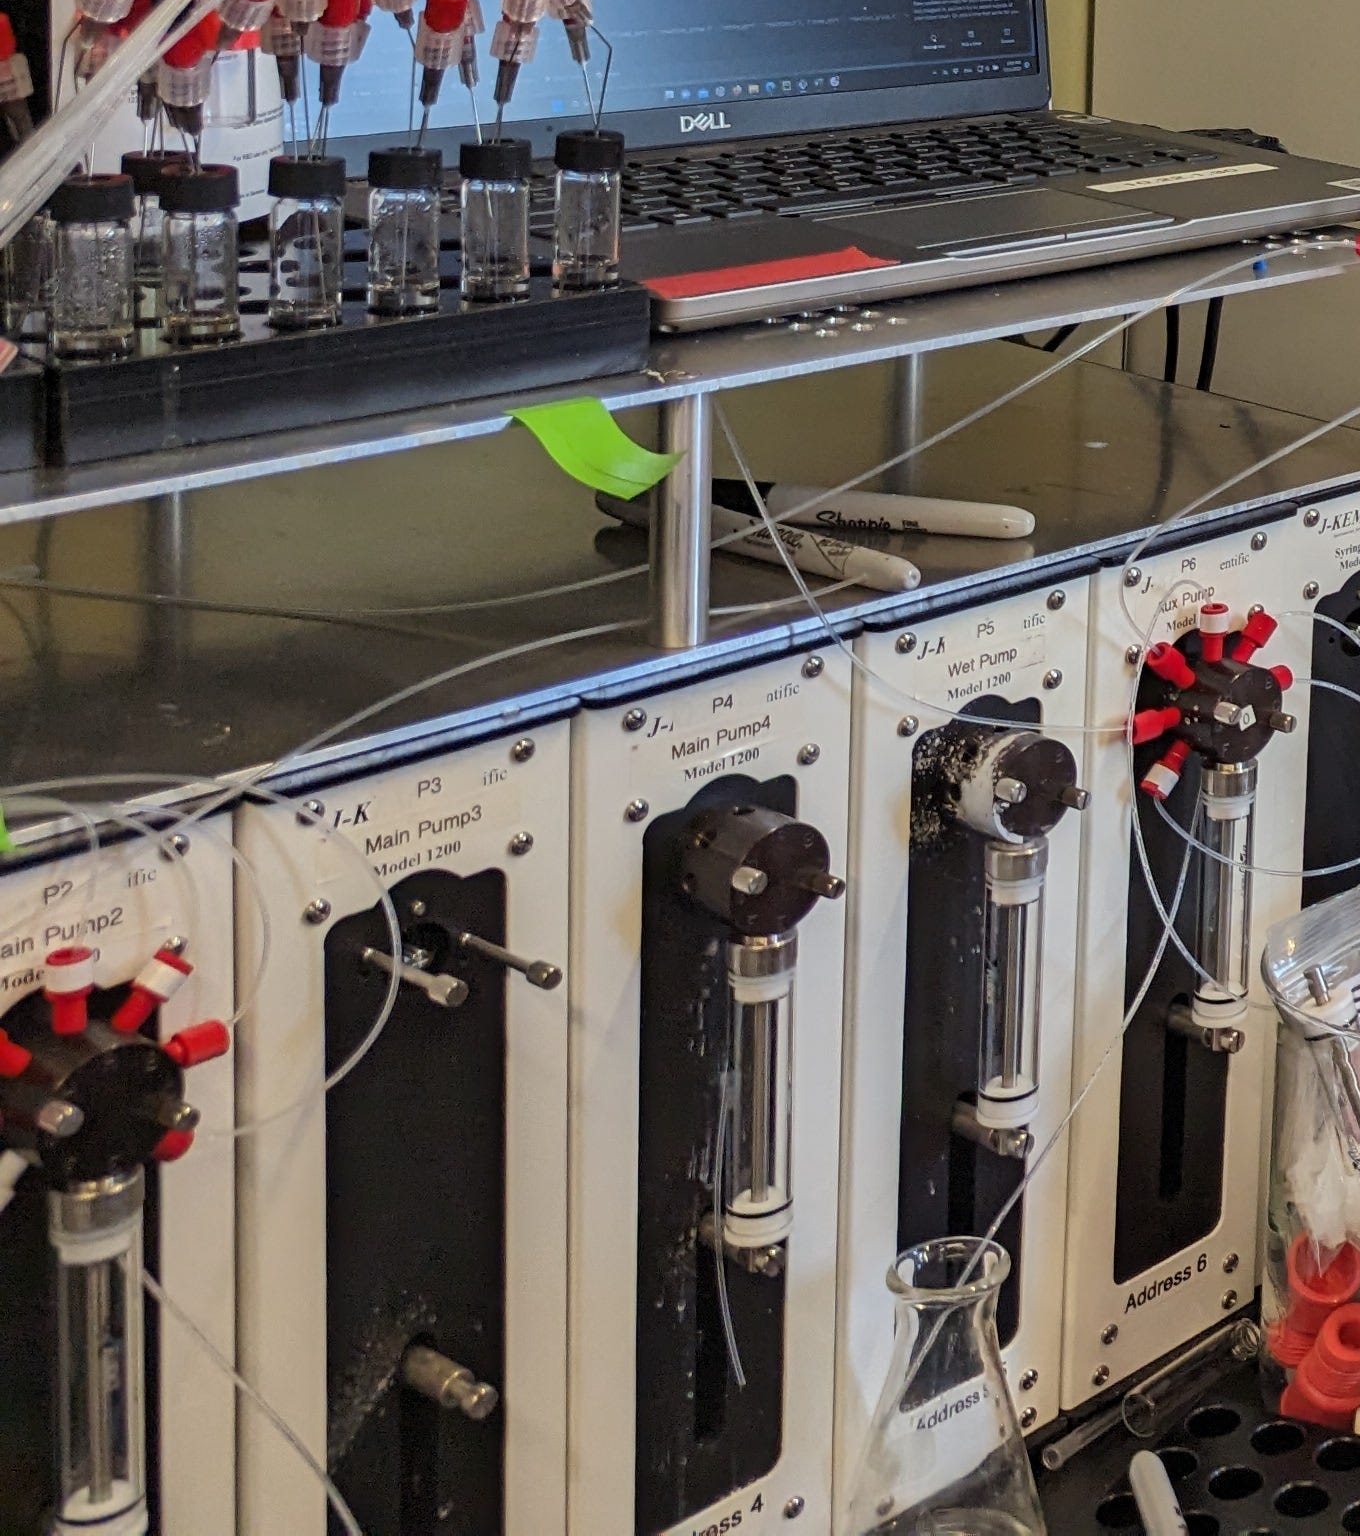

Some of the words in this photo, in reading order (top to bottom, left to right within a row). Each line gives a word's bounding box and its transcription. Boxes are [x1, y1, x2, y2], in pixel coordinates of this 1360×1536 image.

[680, 111, 732, 133] DELL
[1181, 557, 1196, 573] P6
[977, 620, 995, 638] P5
[1166, 613, 1197, 632] Model
[948, 658, 976, 678] Wet
[979, 647, 1018, 669] Pump
[947, 680, 983, 701] Model
[986, 671, 1012, 689] 1200
[712, 694, 734, 713] P4
[671, 737, 710, 760] Main
[716, 714, 771, 747] Pump4
[684, 758, 726, 781] Model
[731, 747, 760, 767] 1200
[417, 776, 442, 798] P3
[366, 829, 410, 856] Main
[418, 804, 483, 839] Pump3
[374, 853, 421, 877] Model
[427, 840, 462, 862] 1200
[43, 881, 73, 905] P2
[0, 937, 34, 959] ain
[45, 907, 124, 946] Pump2
[1124, 1266, 1192, 1314] Address
[1197, 1253, 1207, 1272] 6
[917, 1391, 981, 1431] Address
[751, 1492, 764, 1513] 4
